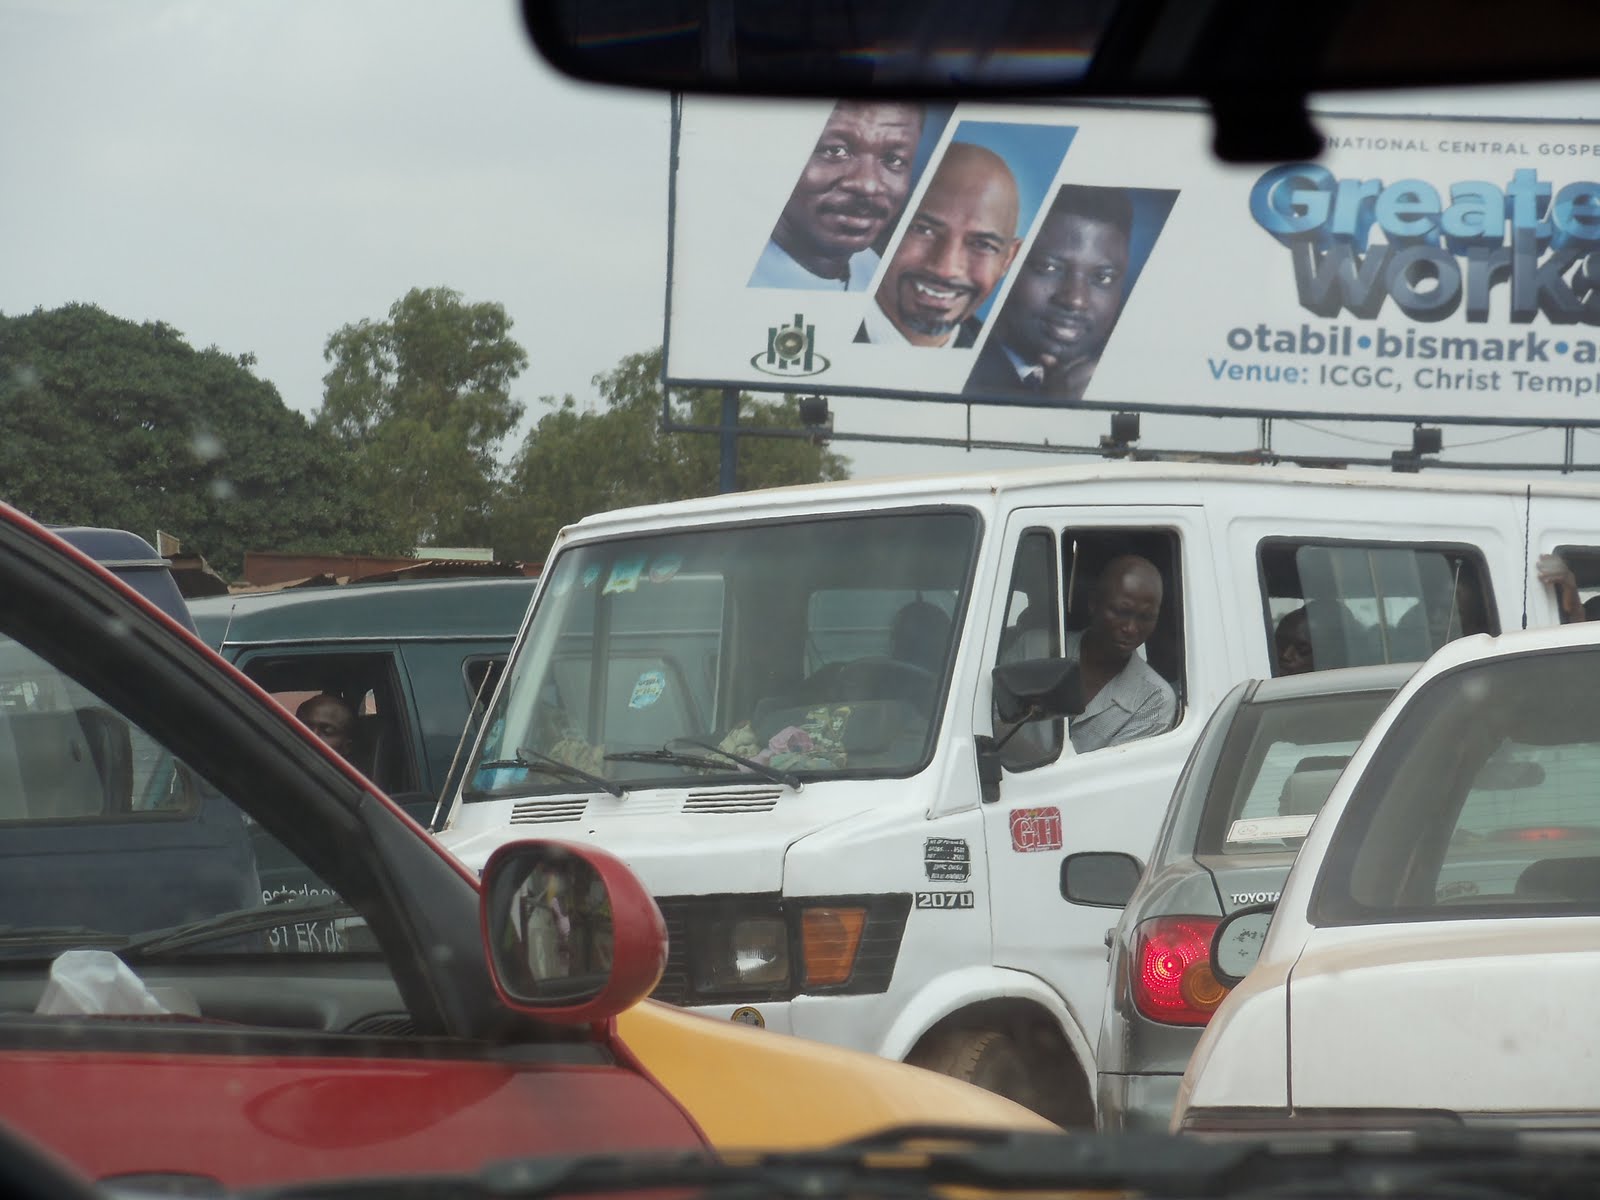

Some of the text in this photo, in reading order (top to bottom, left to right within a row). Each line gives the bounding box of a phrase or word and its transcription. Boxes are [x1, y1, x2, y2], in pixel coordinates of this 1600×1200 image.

[1328, 136, 1429, 153] NATIONAL
[1438, 140, 1528, 156] CENTRAL
[1226, 324, 1352, 356] otabil
[1376, 328, 1551, 364] bismark
[1207, 358, 1600, 397] Venue: ICGC, Christ Templ
[917, 892, 973, 908] 2070
[1231, 891, 1281, 904] TOYOTA
